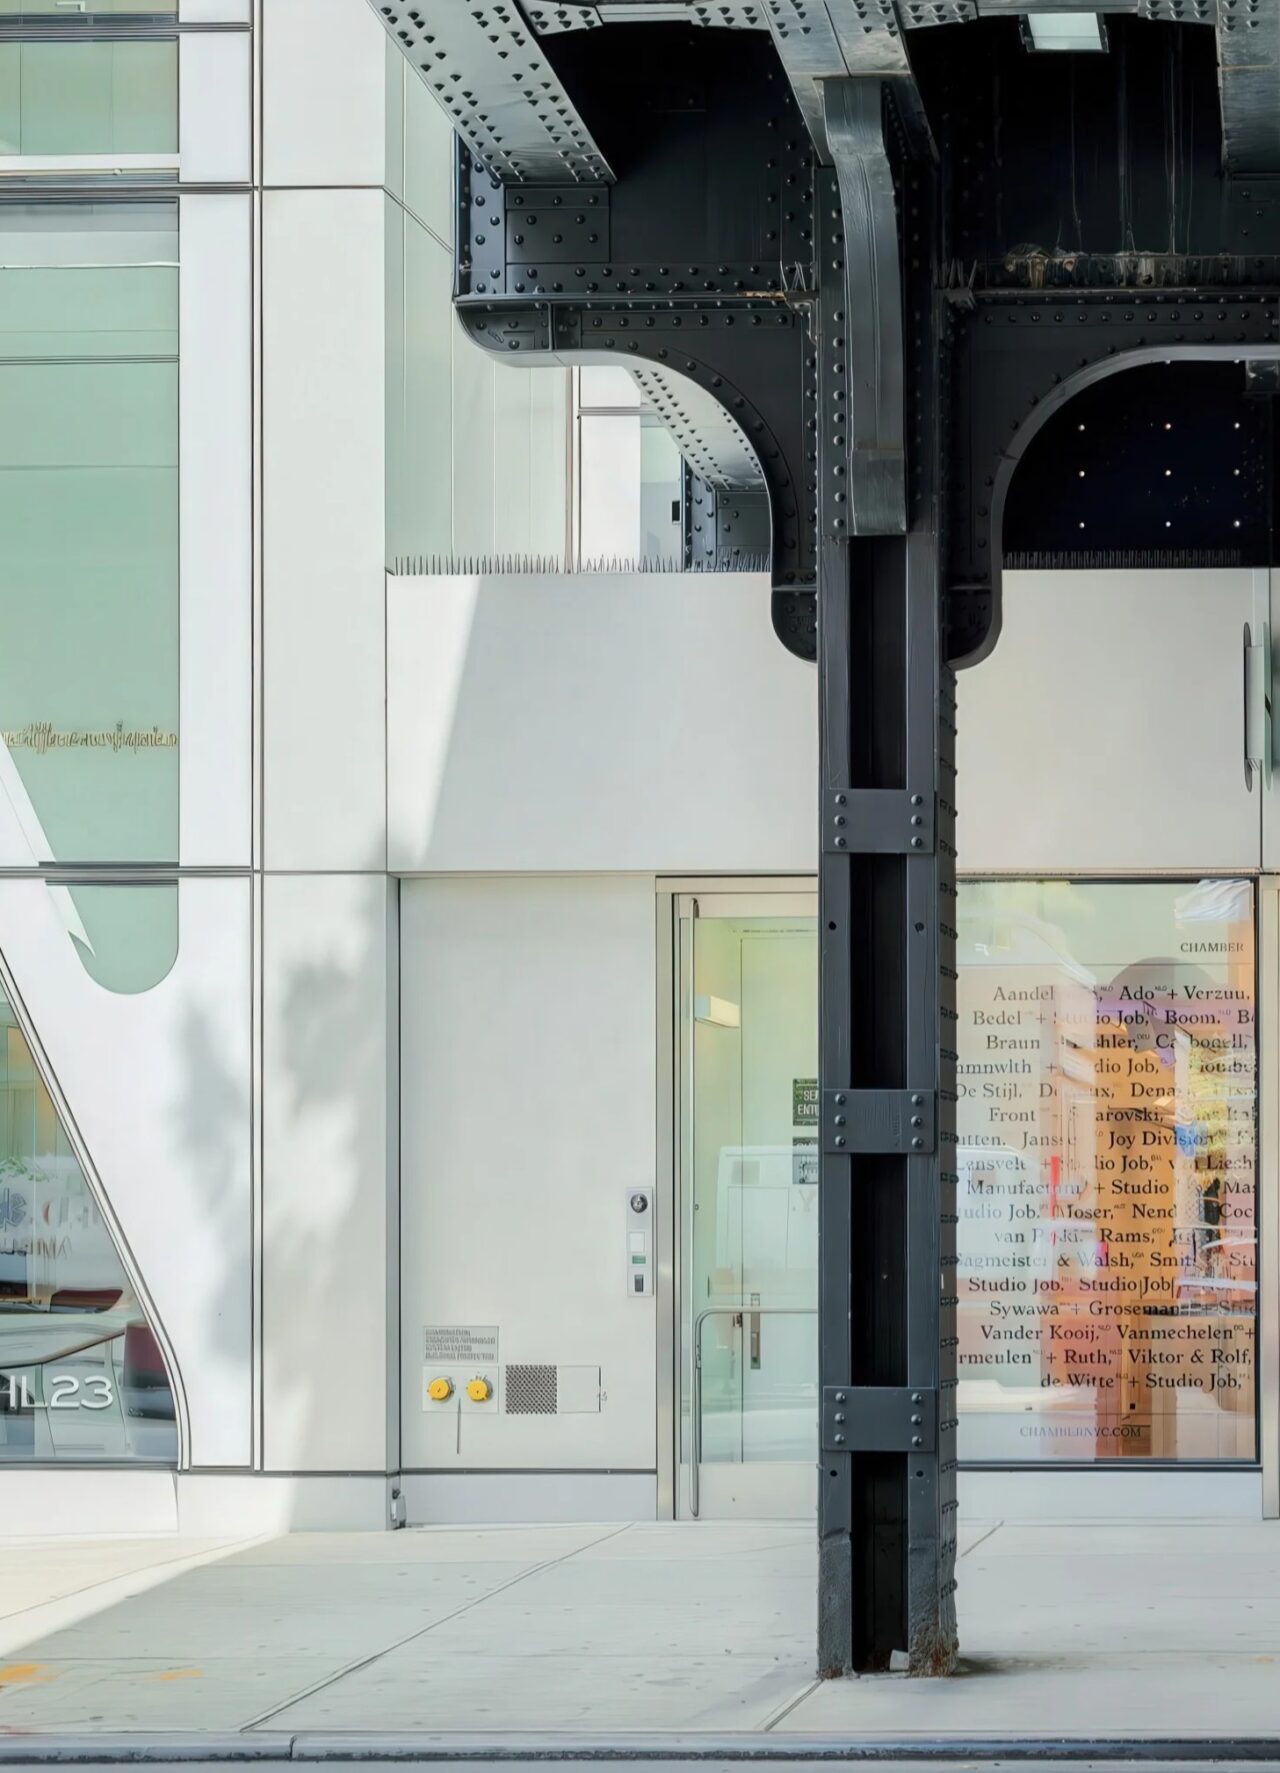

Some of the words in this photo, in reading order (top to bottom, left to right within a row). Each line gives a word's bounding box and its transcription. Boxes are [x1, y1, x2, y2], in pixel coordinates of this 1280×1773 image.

[1179, 942, 1244, 953] CHAMBER
[1119, 985, 1155, 1001] Ado
[972, 1009, 1021, 1026] Bedel
[1117, 1009, 1149, 1027] Job,
[986, 1033, 1040, 1050] Braun
[1127, 1058, 1160, 1078] Job,
[989, 1107, 1036, 1123] Front
[1109, 1131, 1136, 1150] Joy
[1121, 1155, 1154, 1173] Job,
[1111, 1179, 1169, 1195] Studio
[1100, 1228, 1155, 1246] Rams,
[1076, 1252, 1135, 1270] Walsh,
[968, 1277, 1027, 1293] Studio
[1078, 1277, 1138, 1293] Studio
[989, 1301, 1060, 1320] Sywawa
[980, 1325, 1044, 1341] Vander
[1050, 1325, 1101, 1344] Kooij,
[1116, 1325, 1233, 1341] Vanmechelen
[1063, 1349, 1113, 1367] Ruth,
[1128, 1349, 1184, 1365] Viktor
[1190, 1350, 1205, 1365] &
[1210, 1349, 1253, 1367] Rolf,
[1040, 1373, 1062, 1389] de
[1067, 1373, 1116, 1389] Witte
[1145, 1373, 1204, 1389] Studio
[1207, 1373, 1243, 1392] Job,
